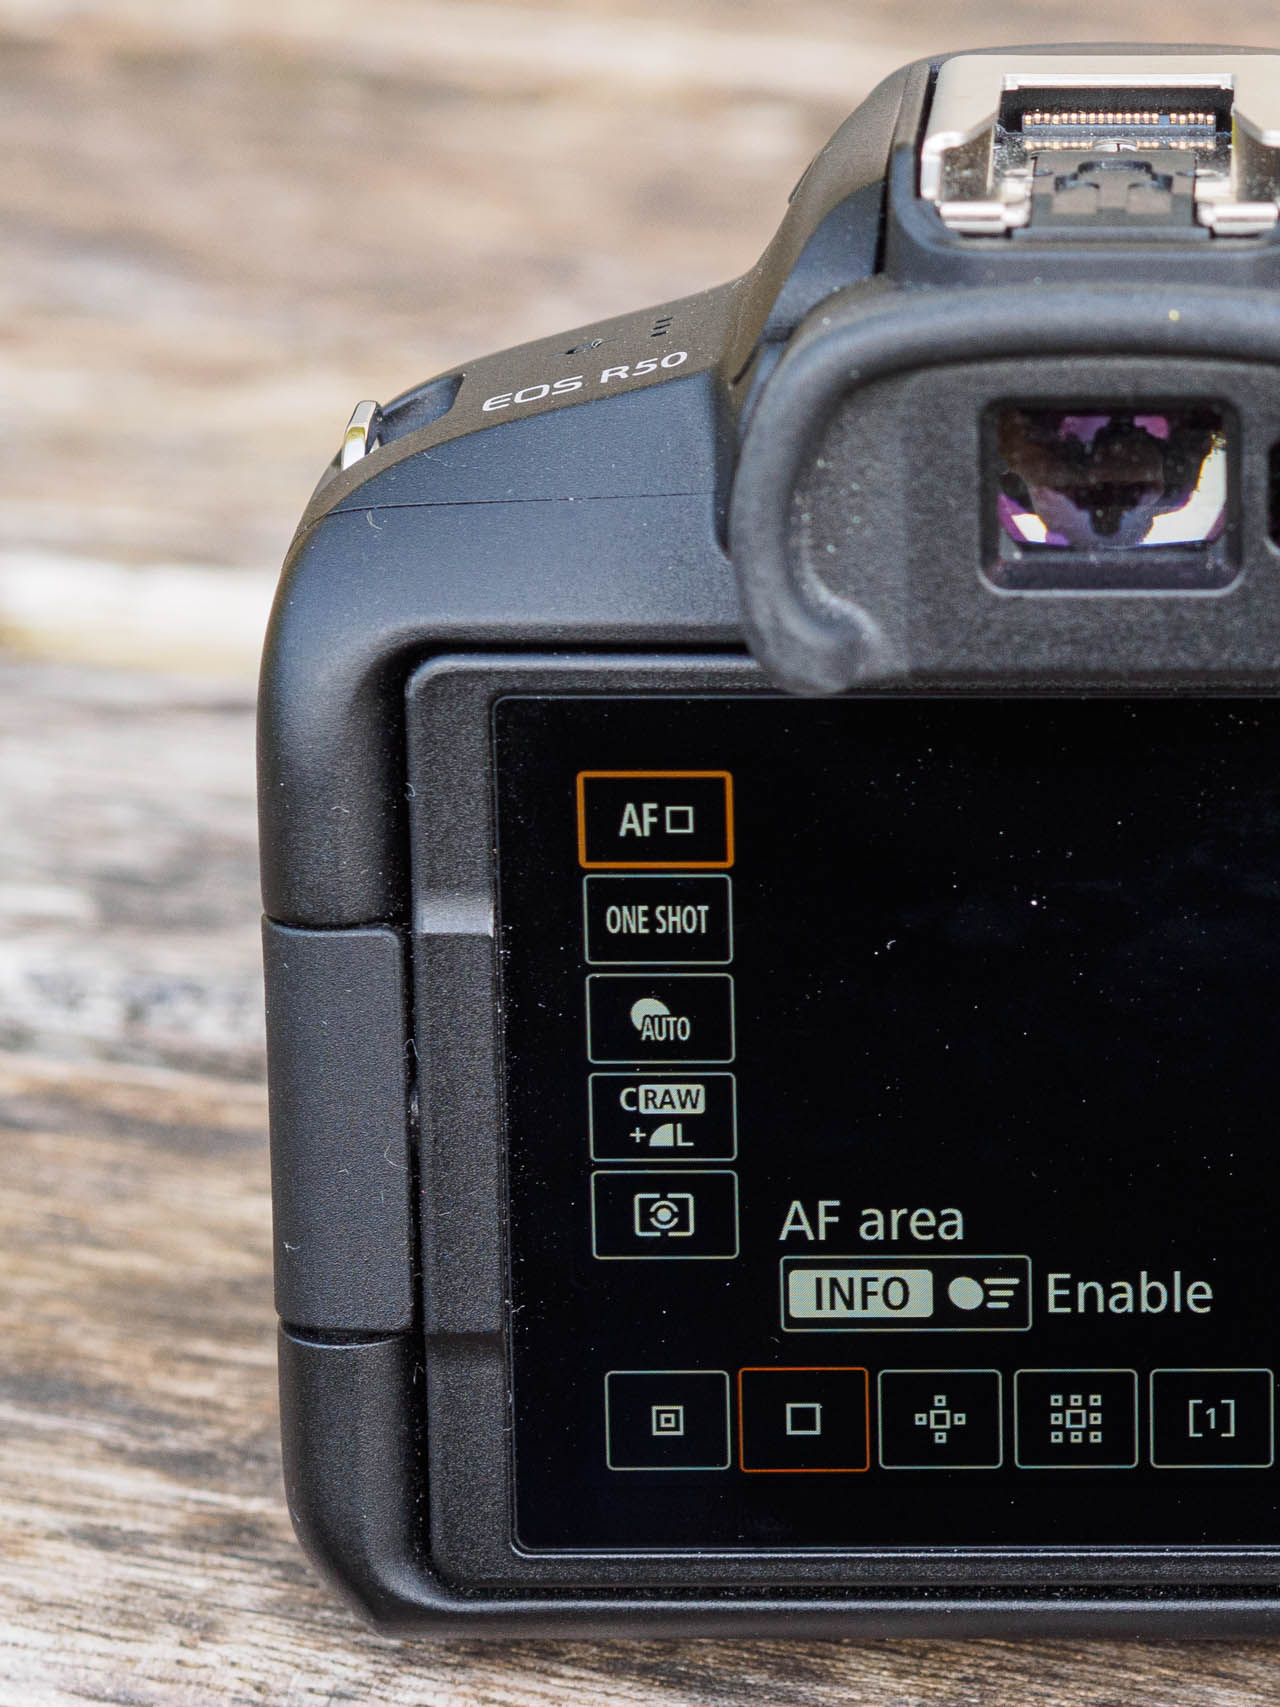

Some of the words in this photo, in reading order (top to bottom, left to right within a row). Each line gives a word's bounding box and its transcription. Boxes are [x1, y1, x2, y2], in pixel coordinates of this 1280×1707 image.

[482, 375, 583, 412] EOS
[600, 351, 688, 384] R50
[620, 804, 657, 837] AF
[606, 906, 648, 934] ONE
[656, 905, 708, 934] SHOT
[642, 1016, 689, 1041] AUTO
[779, 1201, 840, 1240] AF
[859, 1205, 964, 1240] area
[815, 1277, 909, 1311] INFO
[1047, 1272, 1213, 1313] Enable
